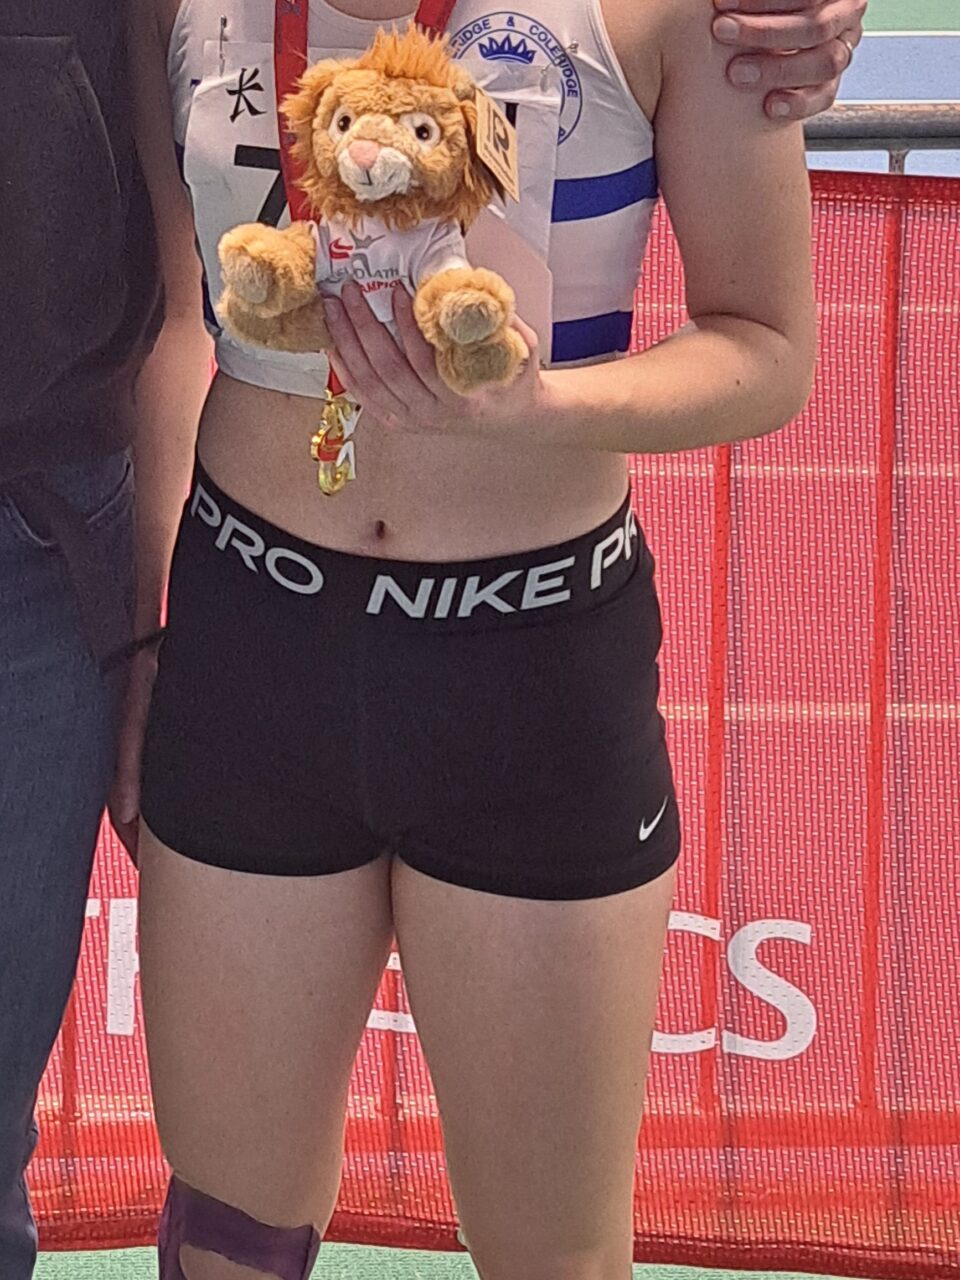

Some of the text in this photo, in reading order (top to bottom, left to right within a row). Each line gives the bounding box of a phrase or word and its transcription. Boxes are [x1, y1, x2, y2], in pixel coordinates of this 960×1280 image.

[506, 16, 515, 27] &
[191, 483, 324, 595] PRO
[365, 556, 576, 619] NIKE
